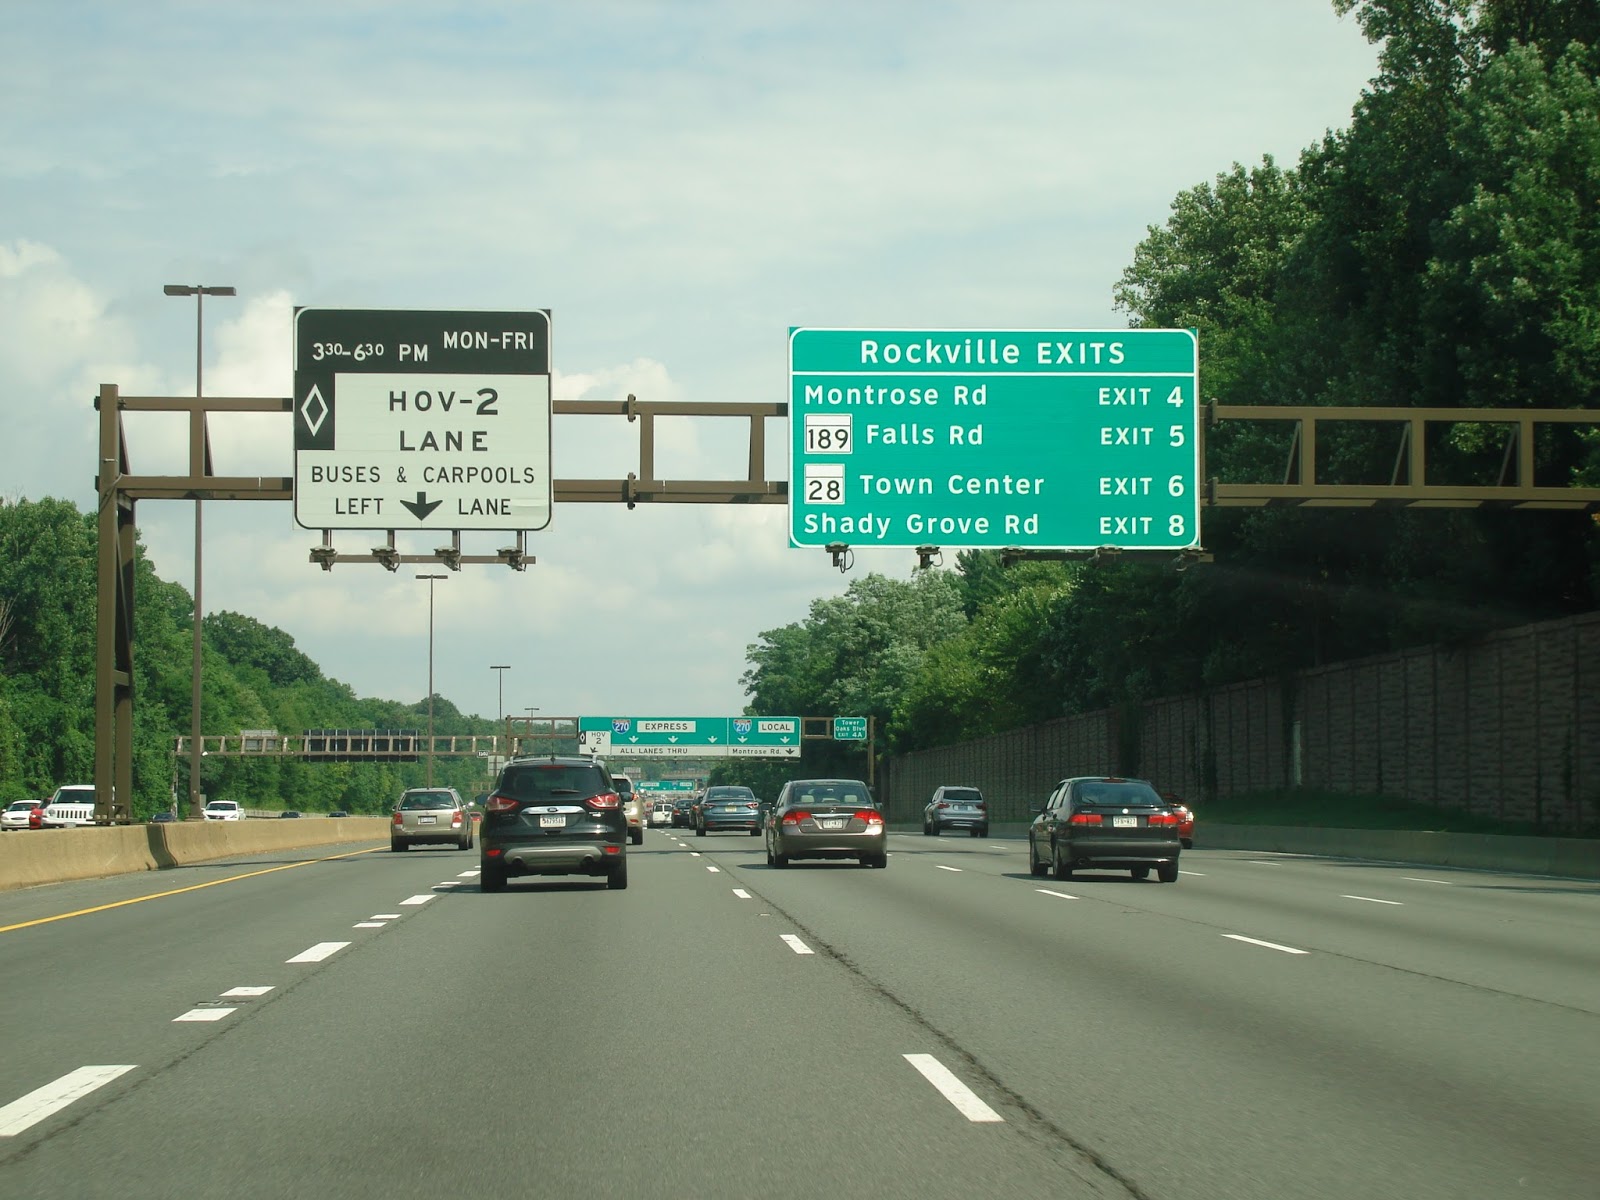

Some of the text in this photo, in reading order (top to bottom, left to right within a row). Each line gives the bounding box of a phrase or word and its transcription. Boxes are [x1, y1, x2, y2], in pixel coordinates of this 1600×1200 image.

[443, 330, 534, 350] MON-FRI
[399, 344, 428, 362] PM
[861, 339, 1125, 365] Rockville EXITS
[389, 387, 499, 416] HOV-2
[804, 384, 1184, 408] Montrose Rd EXIT 4
[399, 430, 488, 452] LANE
[807, 423, 1185, 450] 189 Falls Rd EXIT 5
[311, 465, 535, 484] BUSES & CARPOOLS
[808, 474, 1185, 501] 28 Town Center EXIT 6
[335, 498, 512, 516] LEFT LANE
[804, 512, 1185, 539] Shady Grove Rd EXIT 8
[615, 723, 688, 731] 270 EXPRESS
[761, 723, 791, 731] LOCAL
